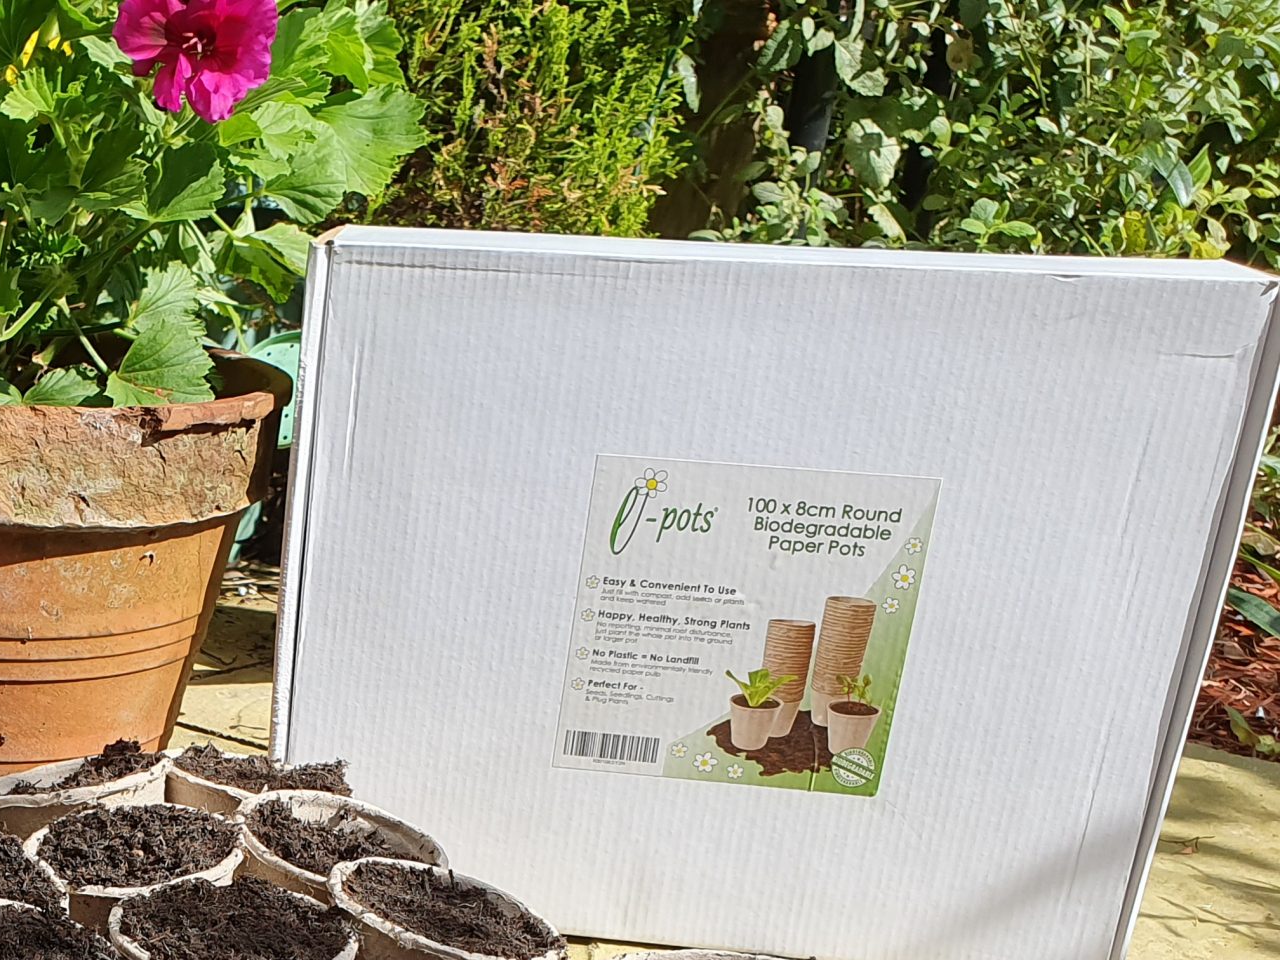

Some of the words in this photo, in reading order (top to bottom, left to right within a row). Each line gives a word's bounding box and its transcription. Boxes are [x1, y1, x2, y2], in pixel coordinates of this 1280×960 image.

[746, 497, 777, 515] 100
[781, 504, 792, 515] x
[795, 502, 836, 519] 8cm
[842, 505, 903, 523] Round
[754, 516, 892, 541] Biodegradable
[769, 536, 823, 555] Paper
[828, 541, 866, 557] Pots
[603, 576, 626, 588] Easy
[629, 579, 636, 587] &
[640, 580, 700, 592] Convenient
[704, 584, 715, 594] To
[718, 586, 736, 595] Use
[616, 596, 634, 604] keep
[636, 598, 666, 606] watered
[598, 610, 635, 622] Happy,
[639, 613, 681, 625] Healthy,
[684, 617, 717, 629] Strong
[720, 620, 751, 630] Plants
[644, 624, 671, 632] minimal
[604, 635, 624, 643] larger
[609, 629, 627, 637] plant
[665, 633, 676, 641] pot
[592, 649, 605, 657] No
[609, 650, 638, 660] Plastic
[650, 654, 663, 662] No
[666, 655, 700, 665] Landfill
[590, 666, 621, 674] recycled
[622, 668, 644, 676] paper
[614, 660, 629, 668] from
[631, 663, 686, 673] environmentally
[688, 666, 713, 676] friendly
[588, 680, 620, 689] Perfect
[623, 683, 637, 691] For
[592, 696, 607, 704] Plug
[646, 694, 674, 703] Cuttings
